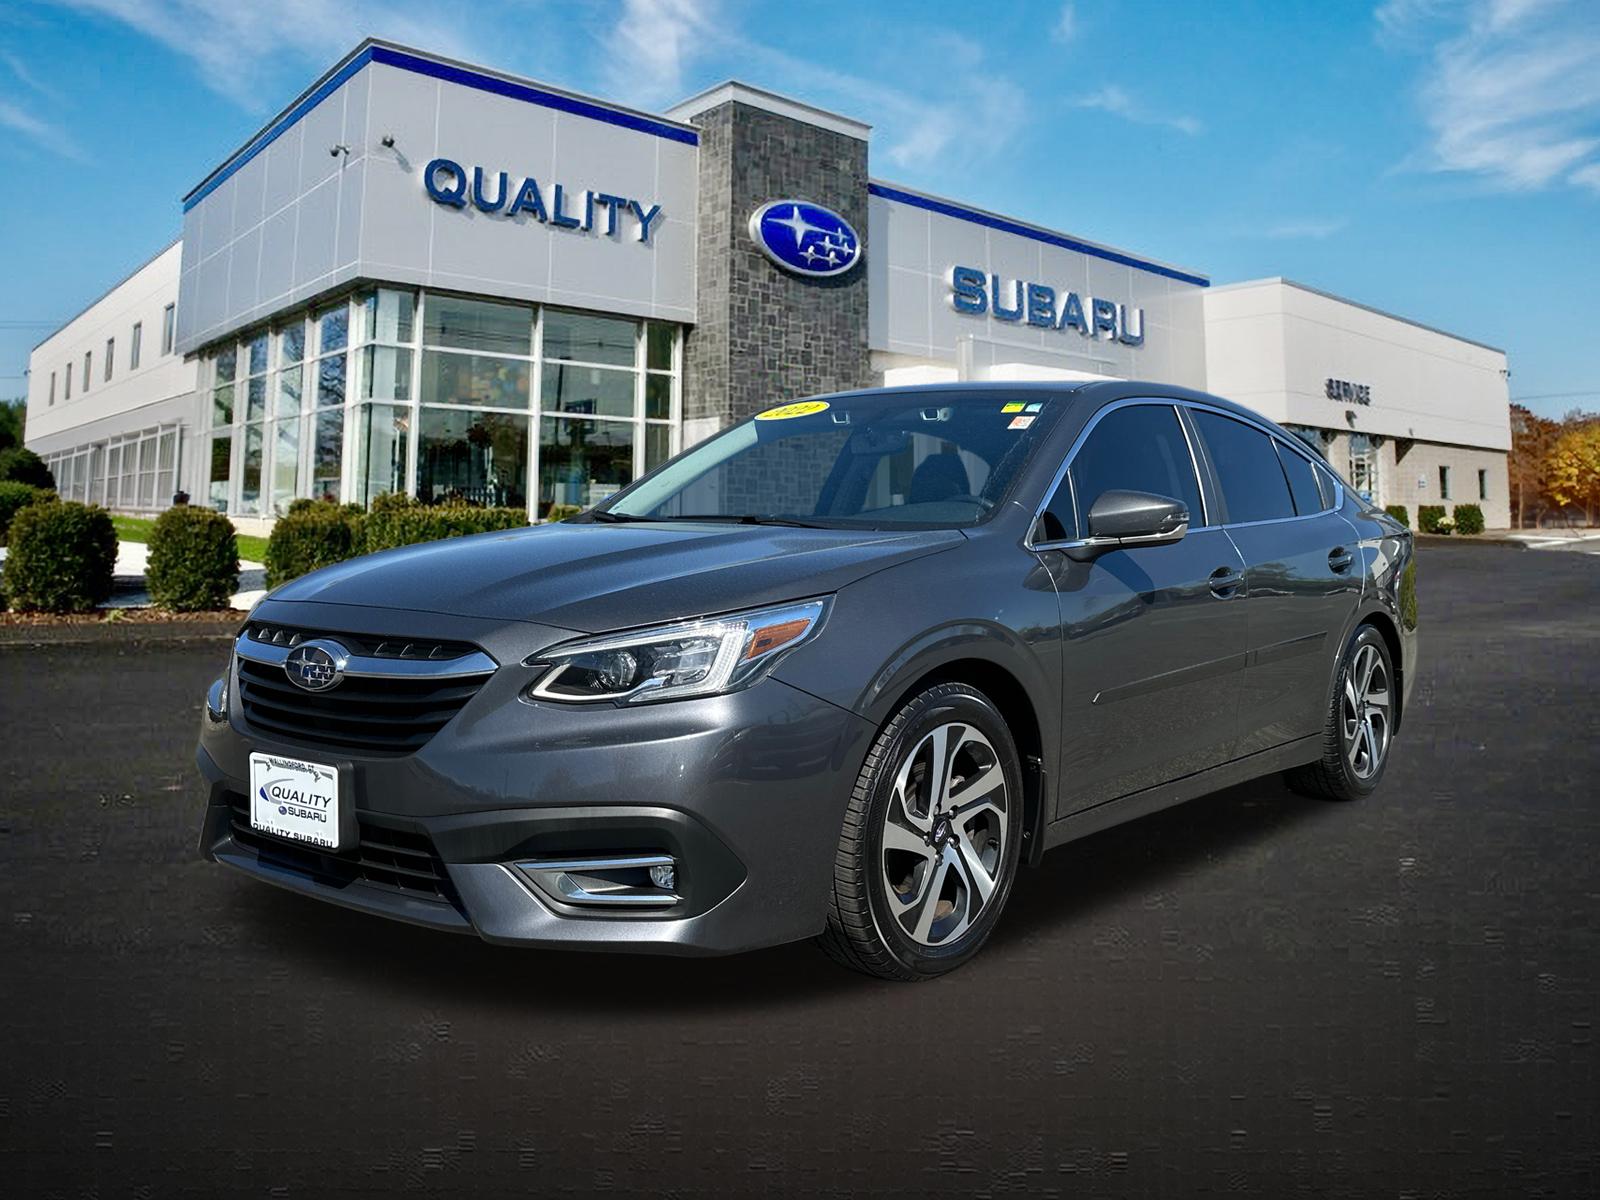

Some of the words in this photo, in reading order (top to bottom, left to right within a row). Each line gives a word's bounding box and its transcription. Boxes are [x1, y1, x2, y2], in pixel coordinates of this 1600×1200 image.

[424, 158, 661, 243] QUALITY
[951, 264, 1145, 347] SUBARU
[1325, 378, 1371, 407] SERVICE
[271, 786, 332, 808] QUALITY
[287, 806, 327, 823] SUBARU
[252, 822, 291, 838] QUALITY
[293, 832, 334, 849] SUBARU
